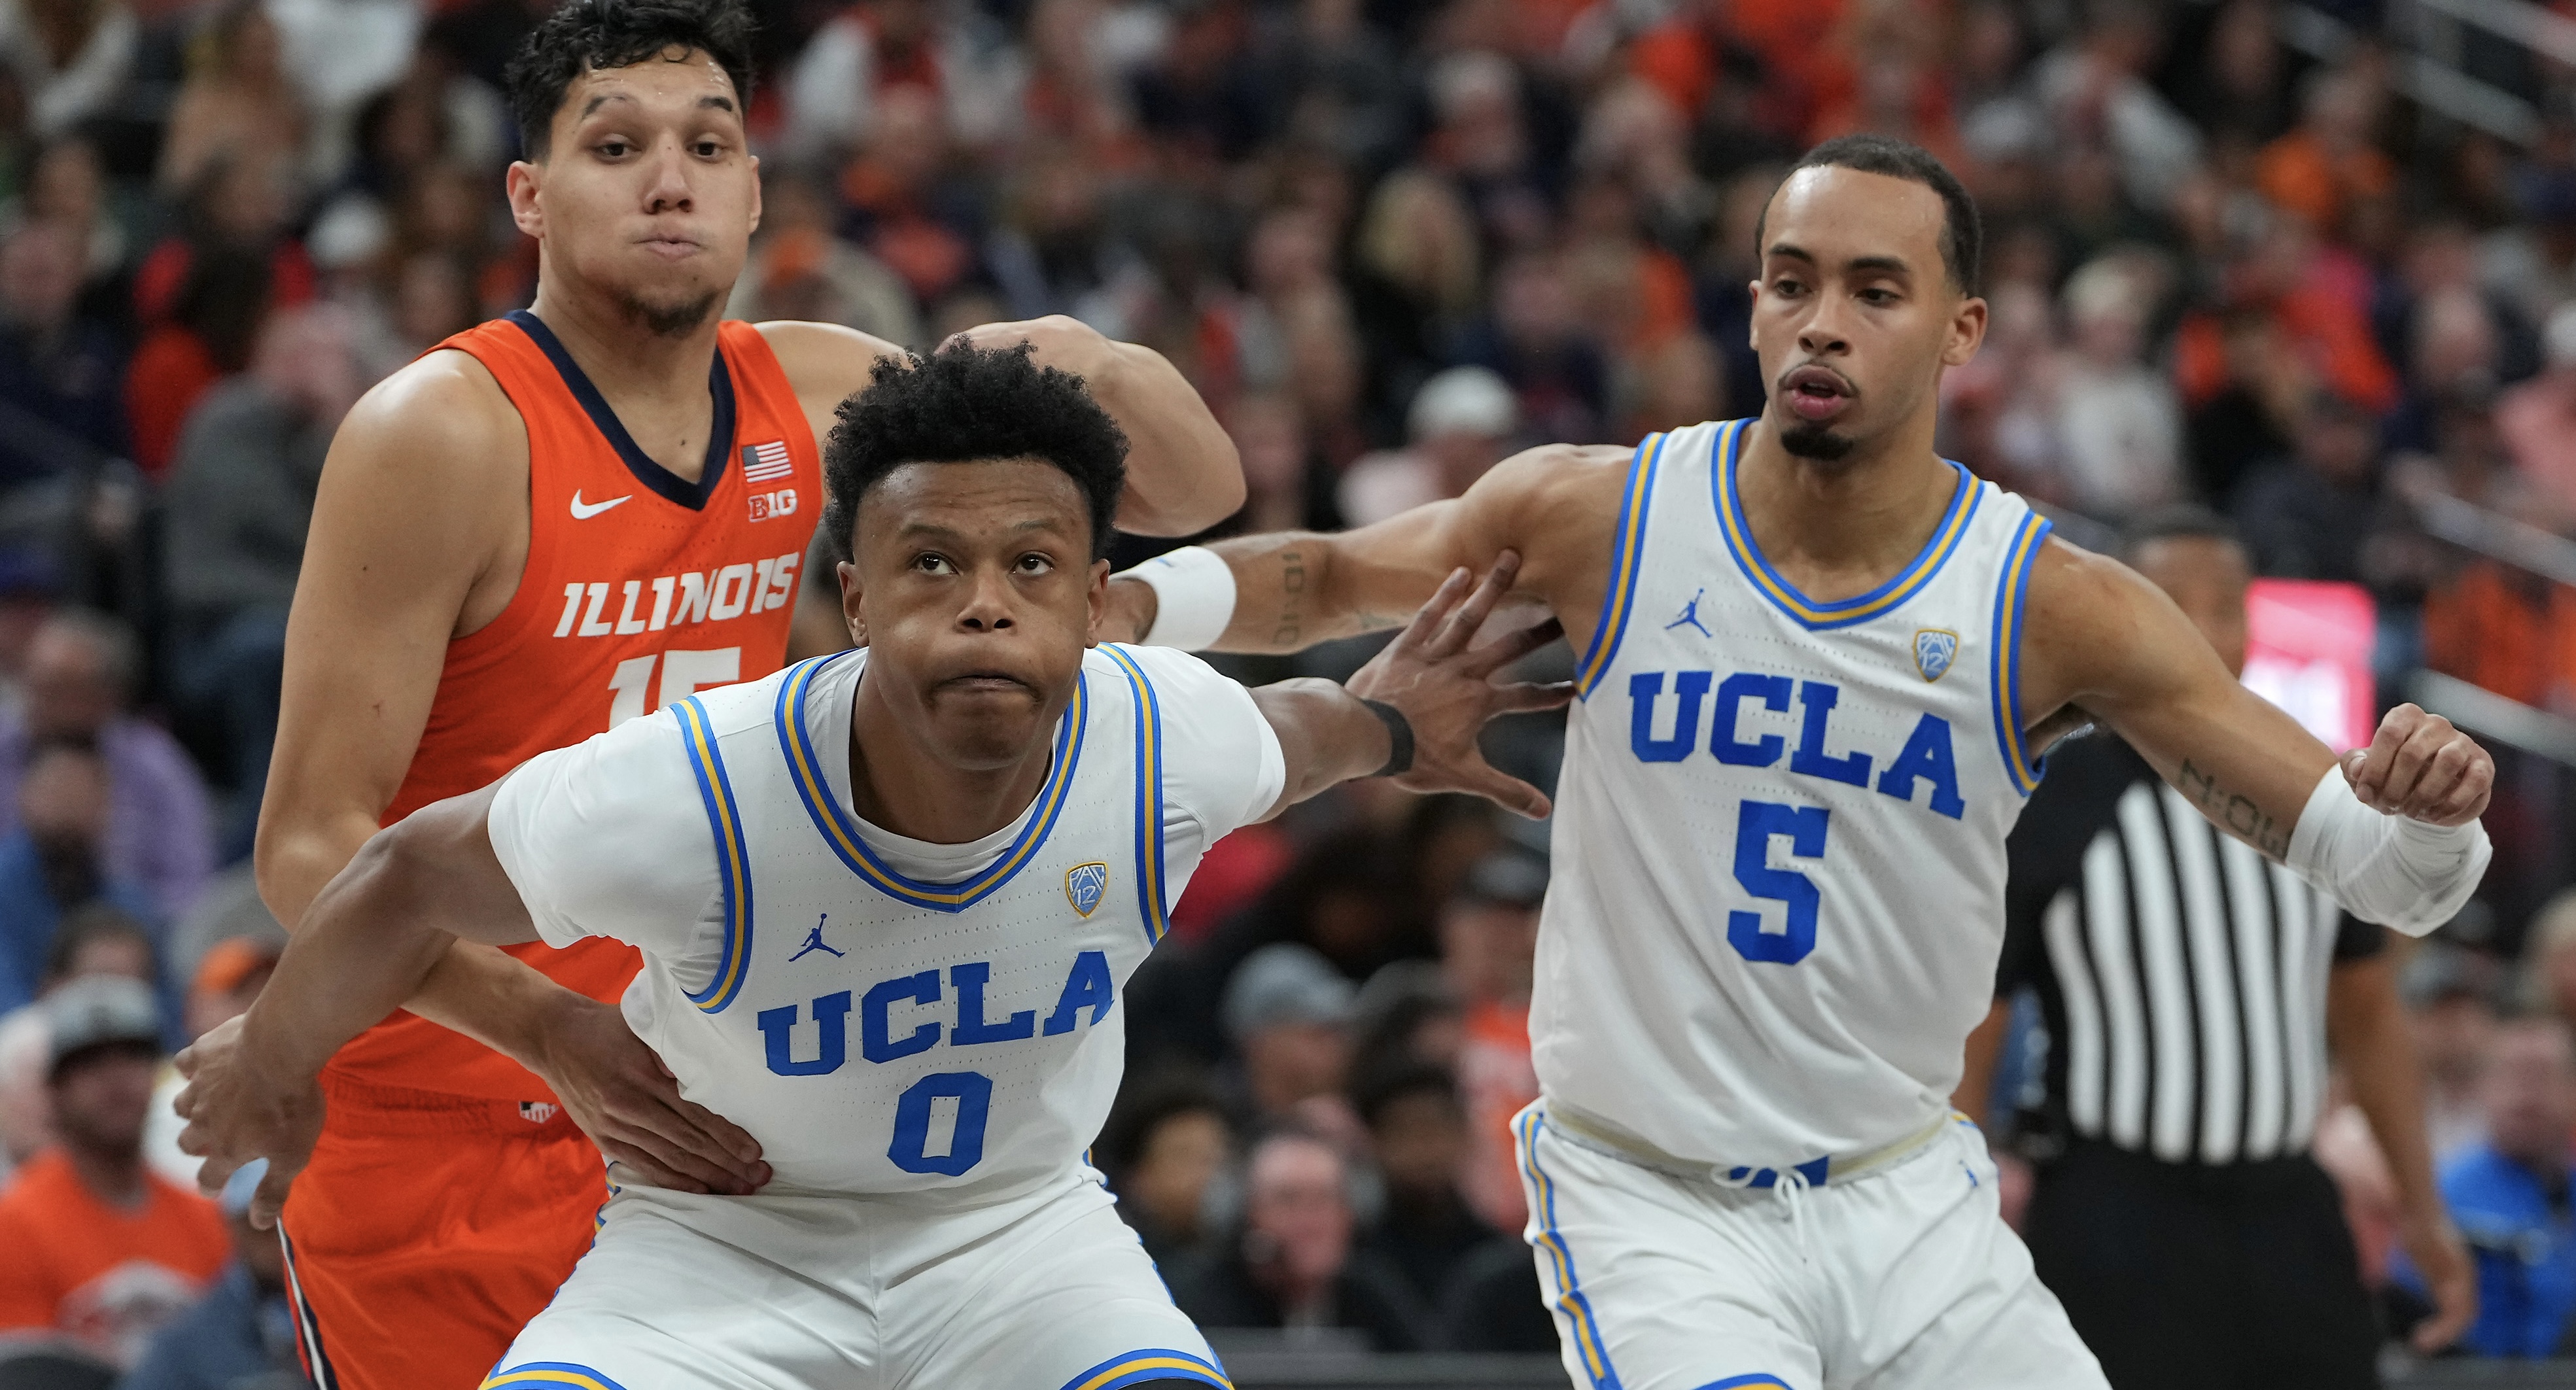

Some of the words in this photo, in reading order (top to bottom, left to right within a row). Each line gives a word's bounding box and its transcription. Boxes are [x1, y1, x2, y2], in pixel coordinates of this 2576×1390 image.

[553, 551, 799, 638] ILLINOIS
[1917, 632, 1956, 662] PAC
[1922, 652, 1943, 671] 12
[1629, 670, 1965, 820] UCLA
[1069, 865, 1104, 897] PAC
[1077, 885, 1096, 907] 12
[1728, 799, 1830, 965] 5
[757, 950, 1115, 1076] UCLA
[887, 1071, 993, 1176] 0
